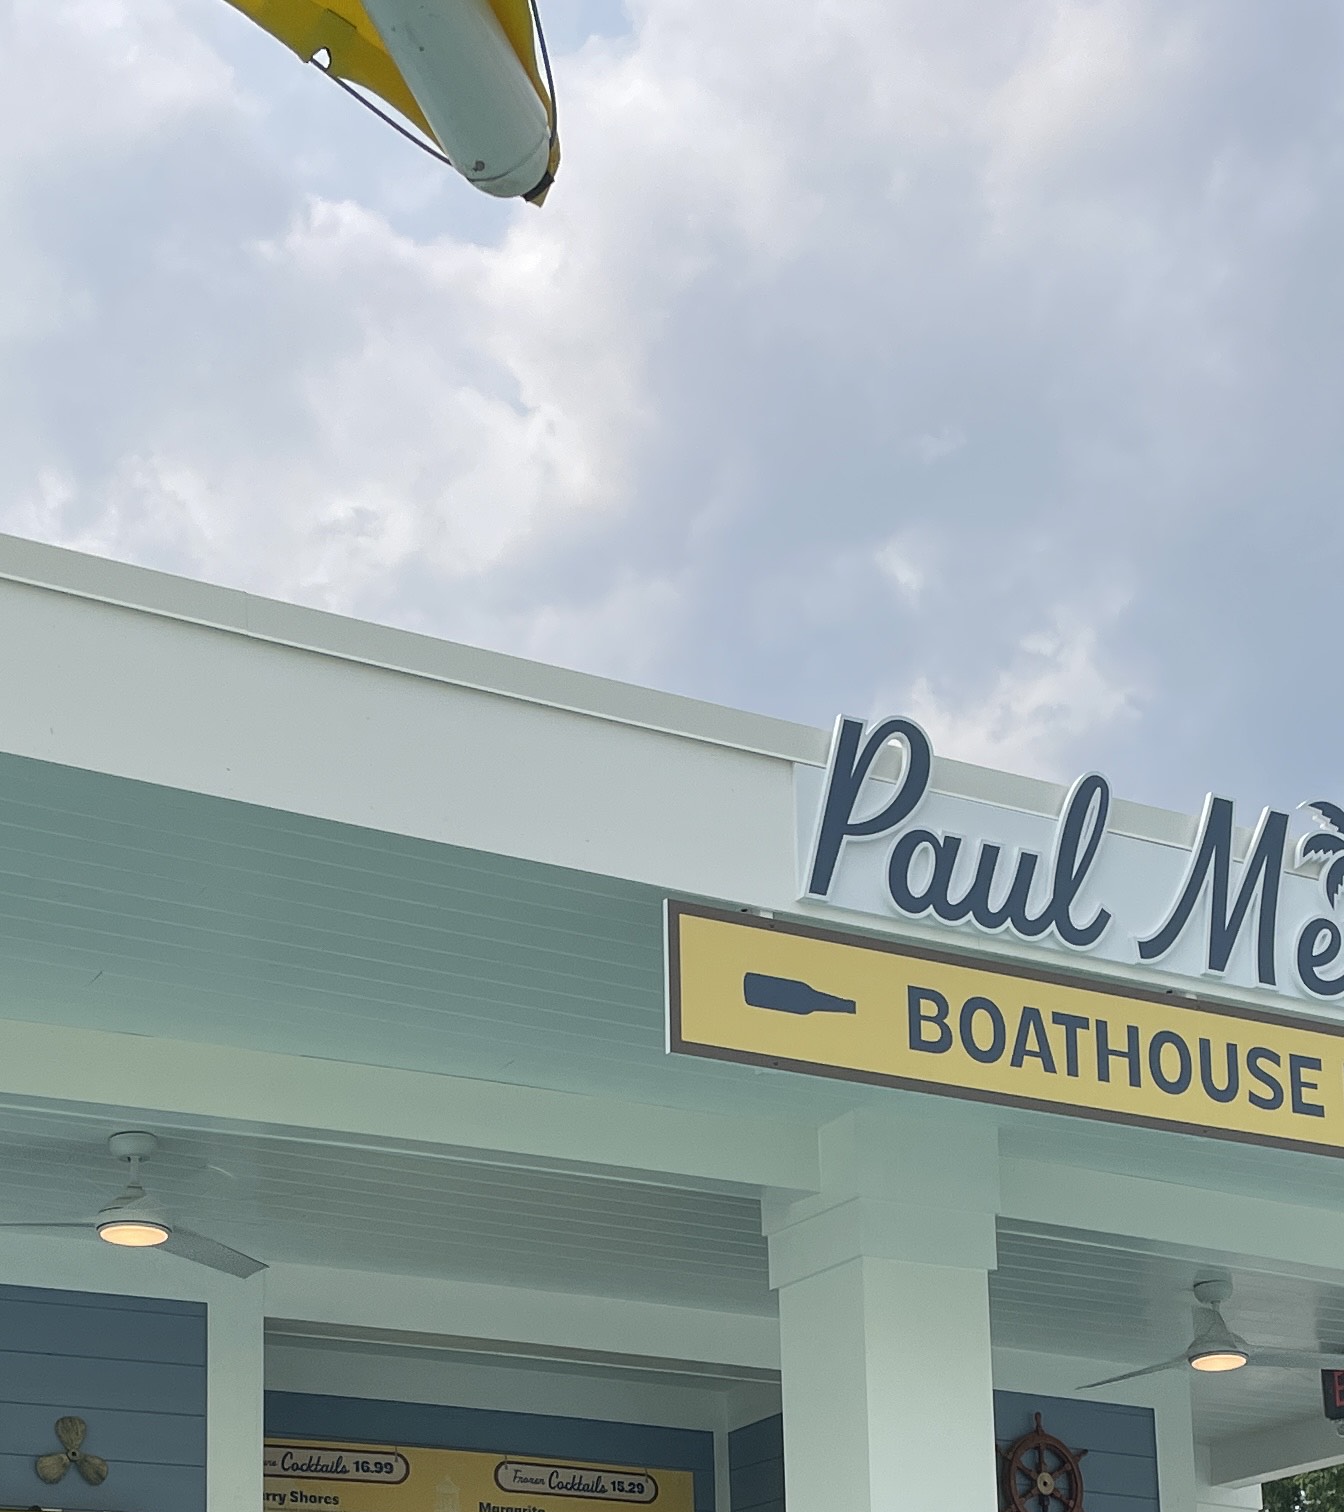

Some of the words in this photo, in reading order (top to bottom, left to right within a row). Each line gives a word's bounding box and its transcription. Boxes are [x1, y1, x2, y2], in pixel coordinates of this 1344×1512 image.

[808, 718, 1112, 948] Paul
[906, 984, 1325, 1118] BOATHOUSE
[281, 1451, 350, 1475] Cocktails
[353, 1460, 394, 1474] 16.99
[512, 1469, 546, 1485] Frozen
[548, 1470, 609, 1494] Cocktails
[610, 1480, 645, 1494] 15.29
[263, 1492, 287, 1505] rry
[290, 1490, 340, 1505] Shores
